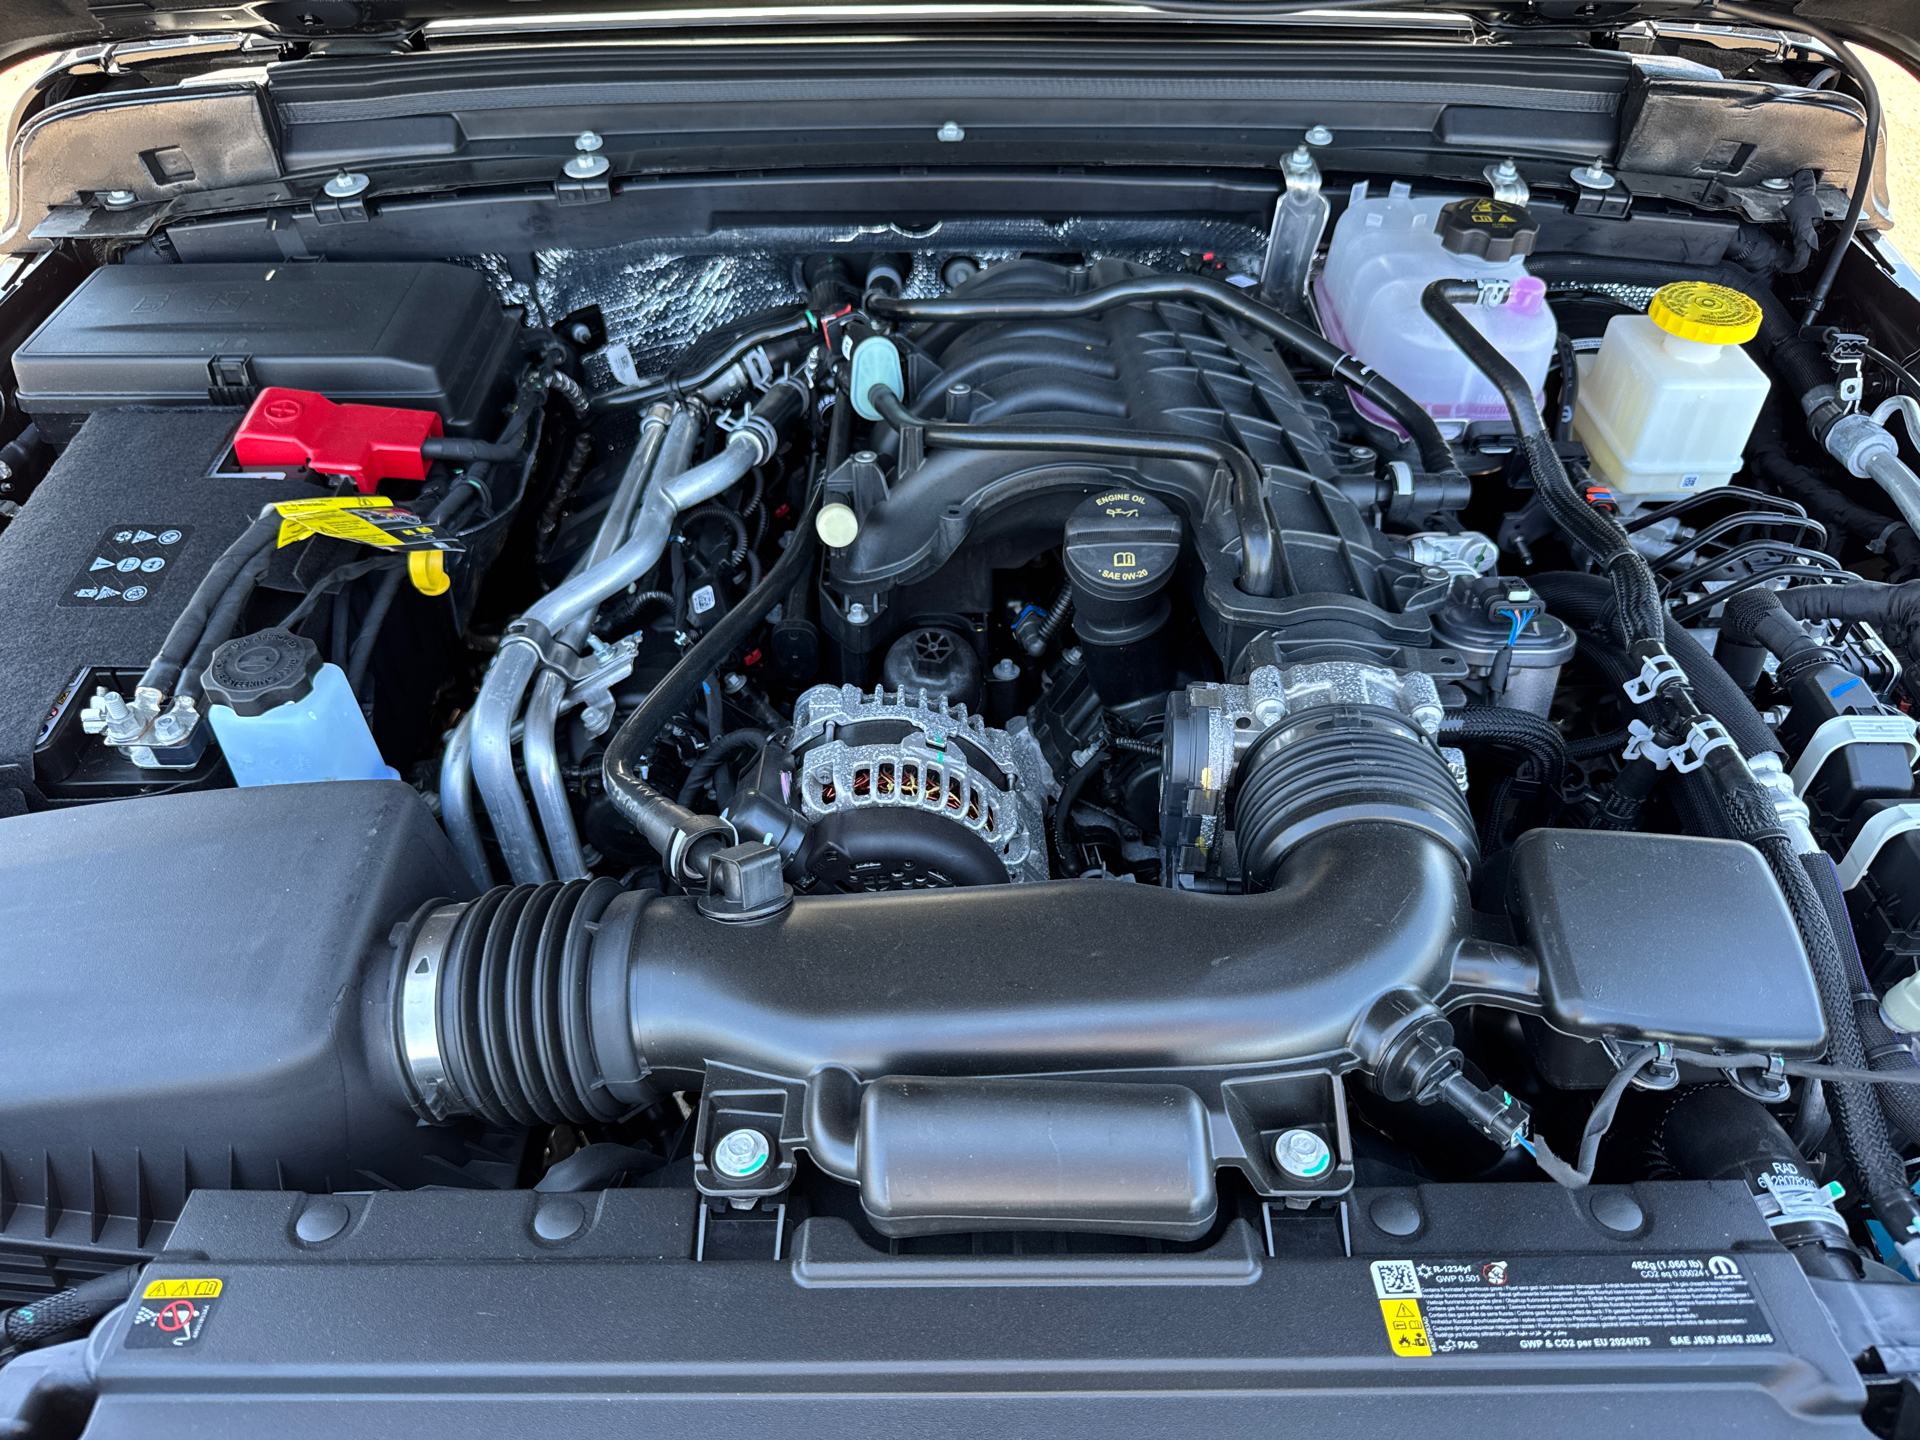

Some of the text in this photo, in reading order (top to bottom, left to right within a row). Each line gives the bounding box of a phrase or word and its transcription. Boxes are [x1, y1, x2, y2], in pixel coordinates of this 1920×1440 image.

[1095, 493, 1146, 506] ENGINE OIL
[1102, 568, 1149, 581] SAE 0W-20
[1771, 1162, 1798, 1175] RAD
[1432, 1265, 1472, 1275] R-1234yf
[1631, 1260, 1657, 1271] 482g
[1688, 1259, 1704, 1270] lb)
[1435, 1275, 1481, 1283] GWP 0.501
[1640, 1270, 1659, 1279] CO2
[1660, 1271, 1672, 1280] eq
[1672, 1269, 1704, 1279] 0.00024
[1457, 1340, 1479, 1350] PAG
[1519, 1336, 1651, 1351] GWP & CO2 per EU 2024/573
[1669, 1335, 1692, 1346] SAE
